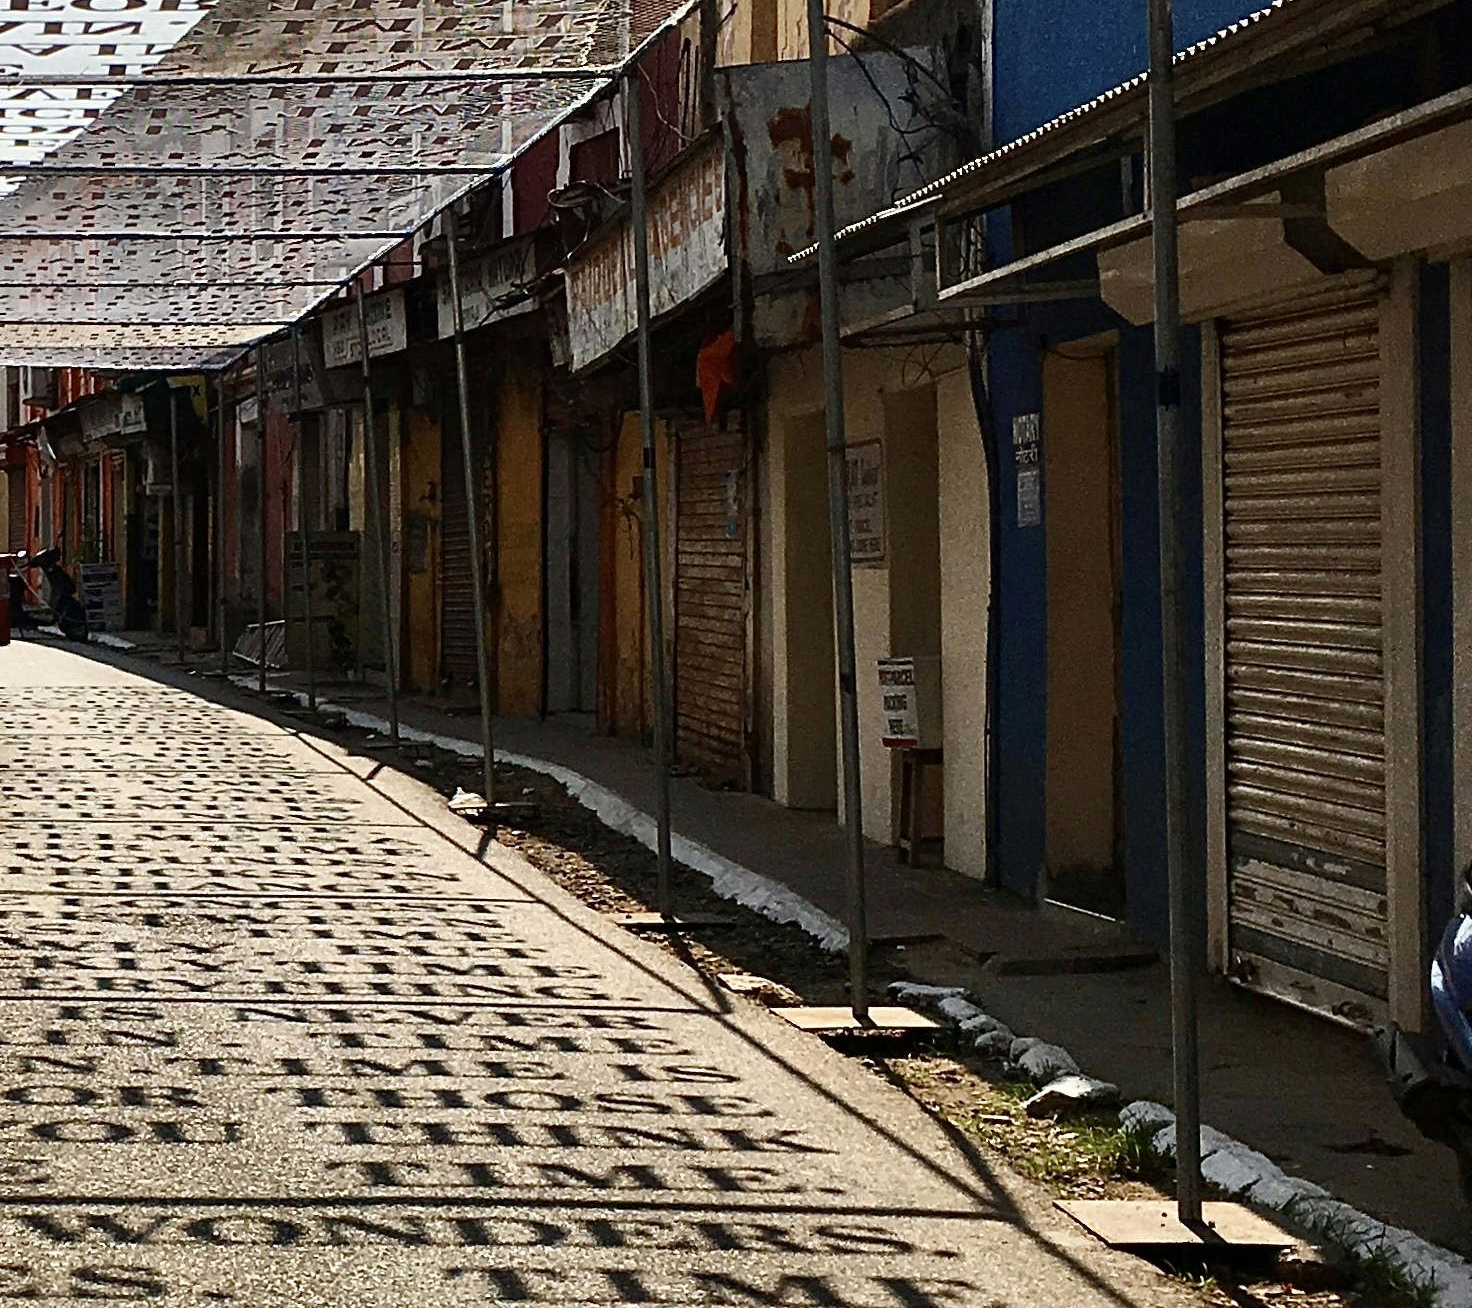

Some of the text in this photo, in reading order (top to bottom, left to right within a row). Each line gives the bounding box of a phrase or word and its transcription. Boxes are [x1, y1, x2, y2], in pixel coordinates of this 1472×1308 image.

[607, 1062, 741, 1084] IS
[265, 1086, 775, 1118] THOSE
[298, 1121, 839, 1154] THINK
